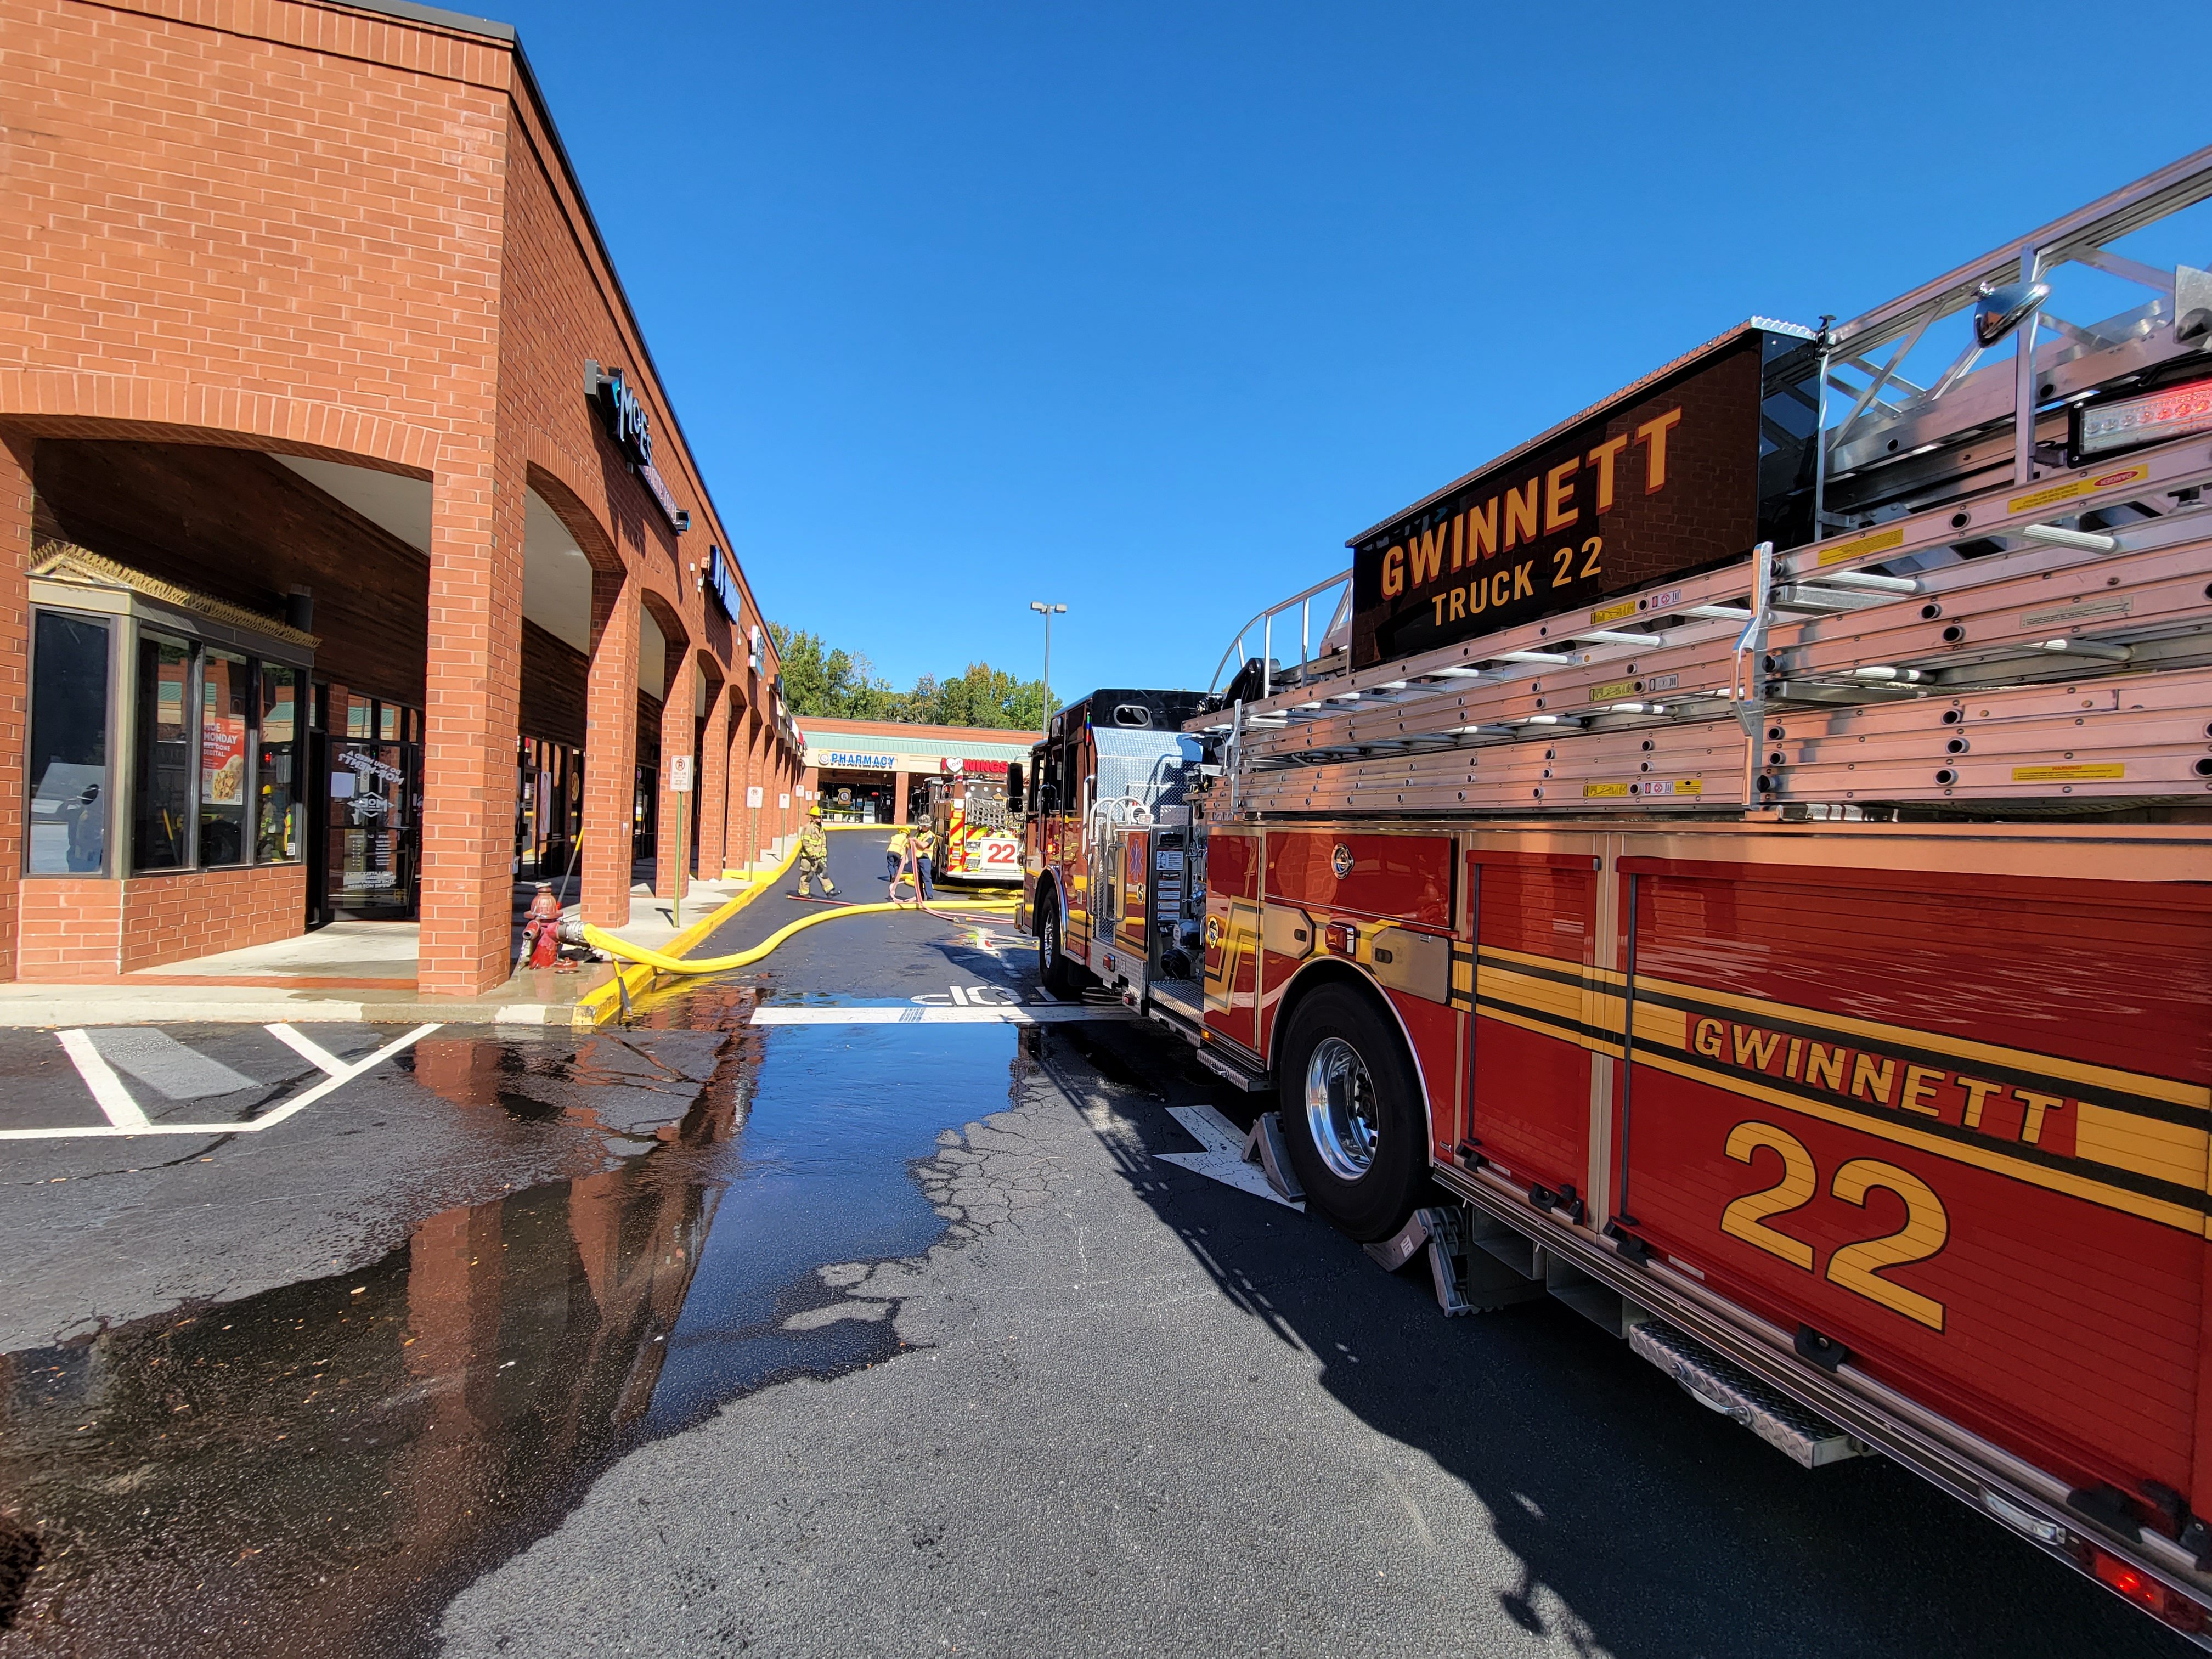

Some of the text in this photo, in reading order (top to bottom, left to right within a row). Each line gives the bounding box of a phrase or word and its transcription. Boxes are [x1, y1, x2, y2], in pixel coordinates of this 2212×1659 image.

[2100, 474, 2132, 485] DANGER
[1381, 405, 1681, 600] GWINNETT
[1431, 537, 1602, 625] TRUCK 22
[204, 732, 238, 744] MONDAY
[831, 753, 895, 766] PHARMACY
[941, 758, 1008, 773] I LOVE WINGS
[987, 843, 1015, 863] 22
[1694, 1018, 2064, 1144] GWINNETT
[1719, 1120, 1950, 1335] 22
